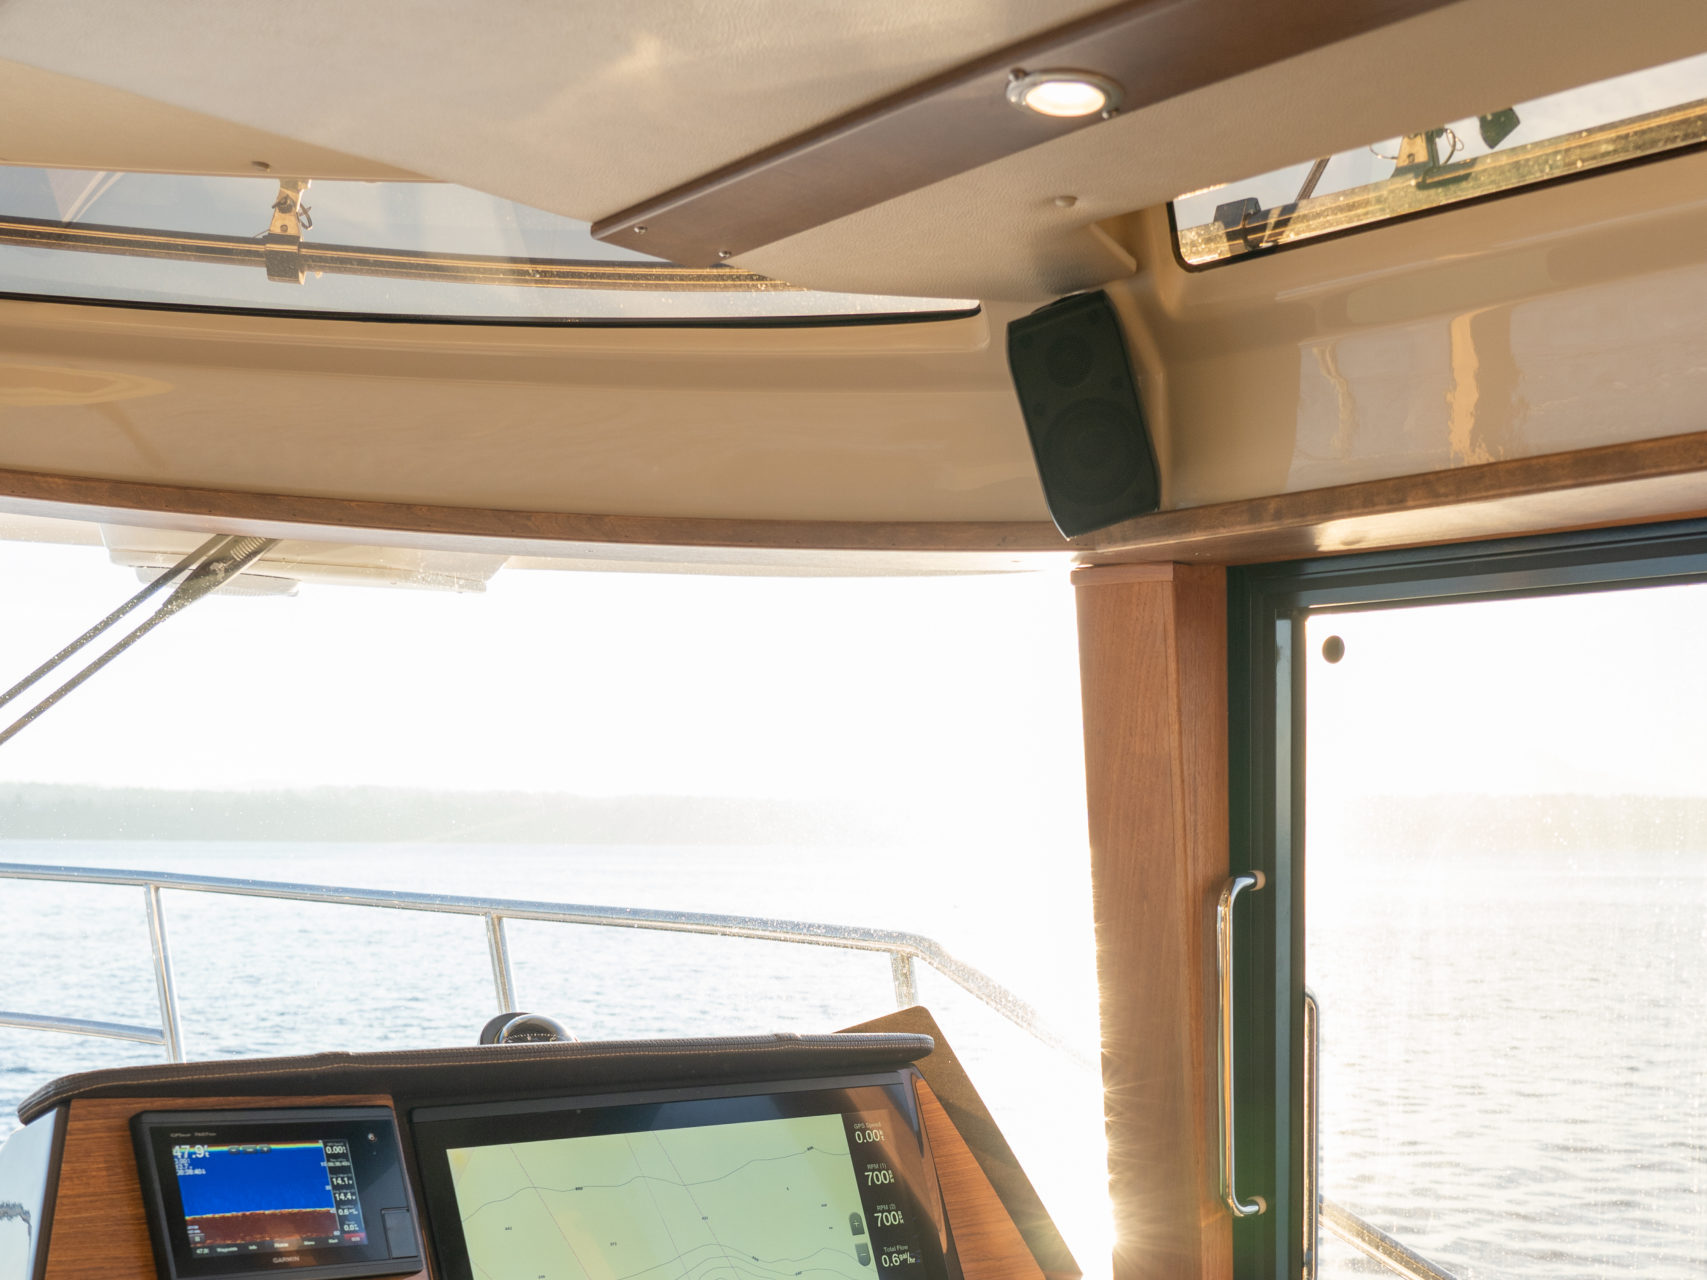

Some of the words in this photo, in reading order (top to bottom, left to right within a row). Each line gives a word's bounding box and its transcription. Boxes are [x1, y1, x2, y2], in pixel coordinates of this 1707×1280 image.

[855, 1129, 880, 1143] 0.00
[864, 1170, 889, 1186] 700
[873, 1211, 899, 1227] 700
[881, 1253, 900, 1268] 0.6
